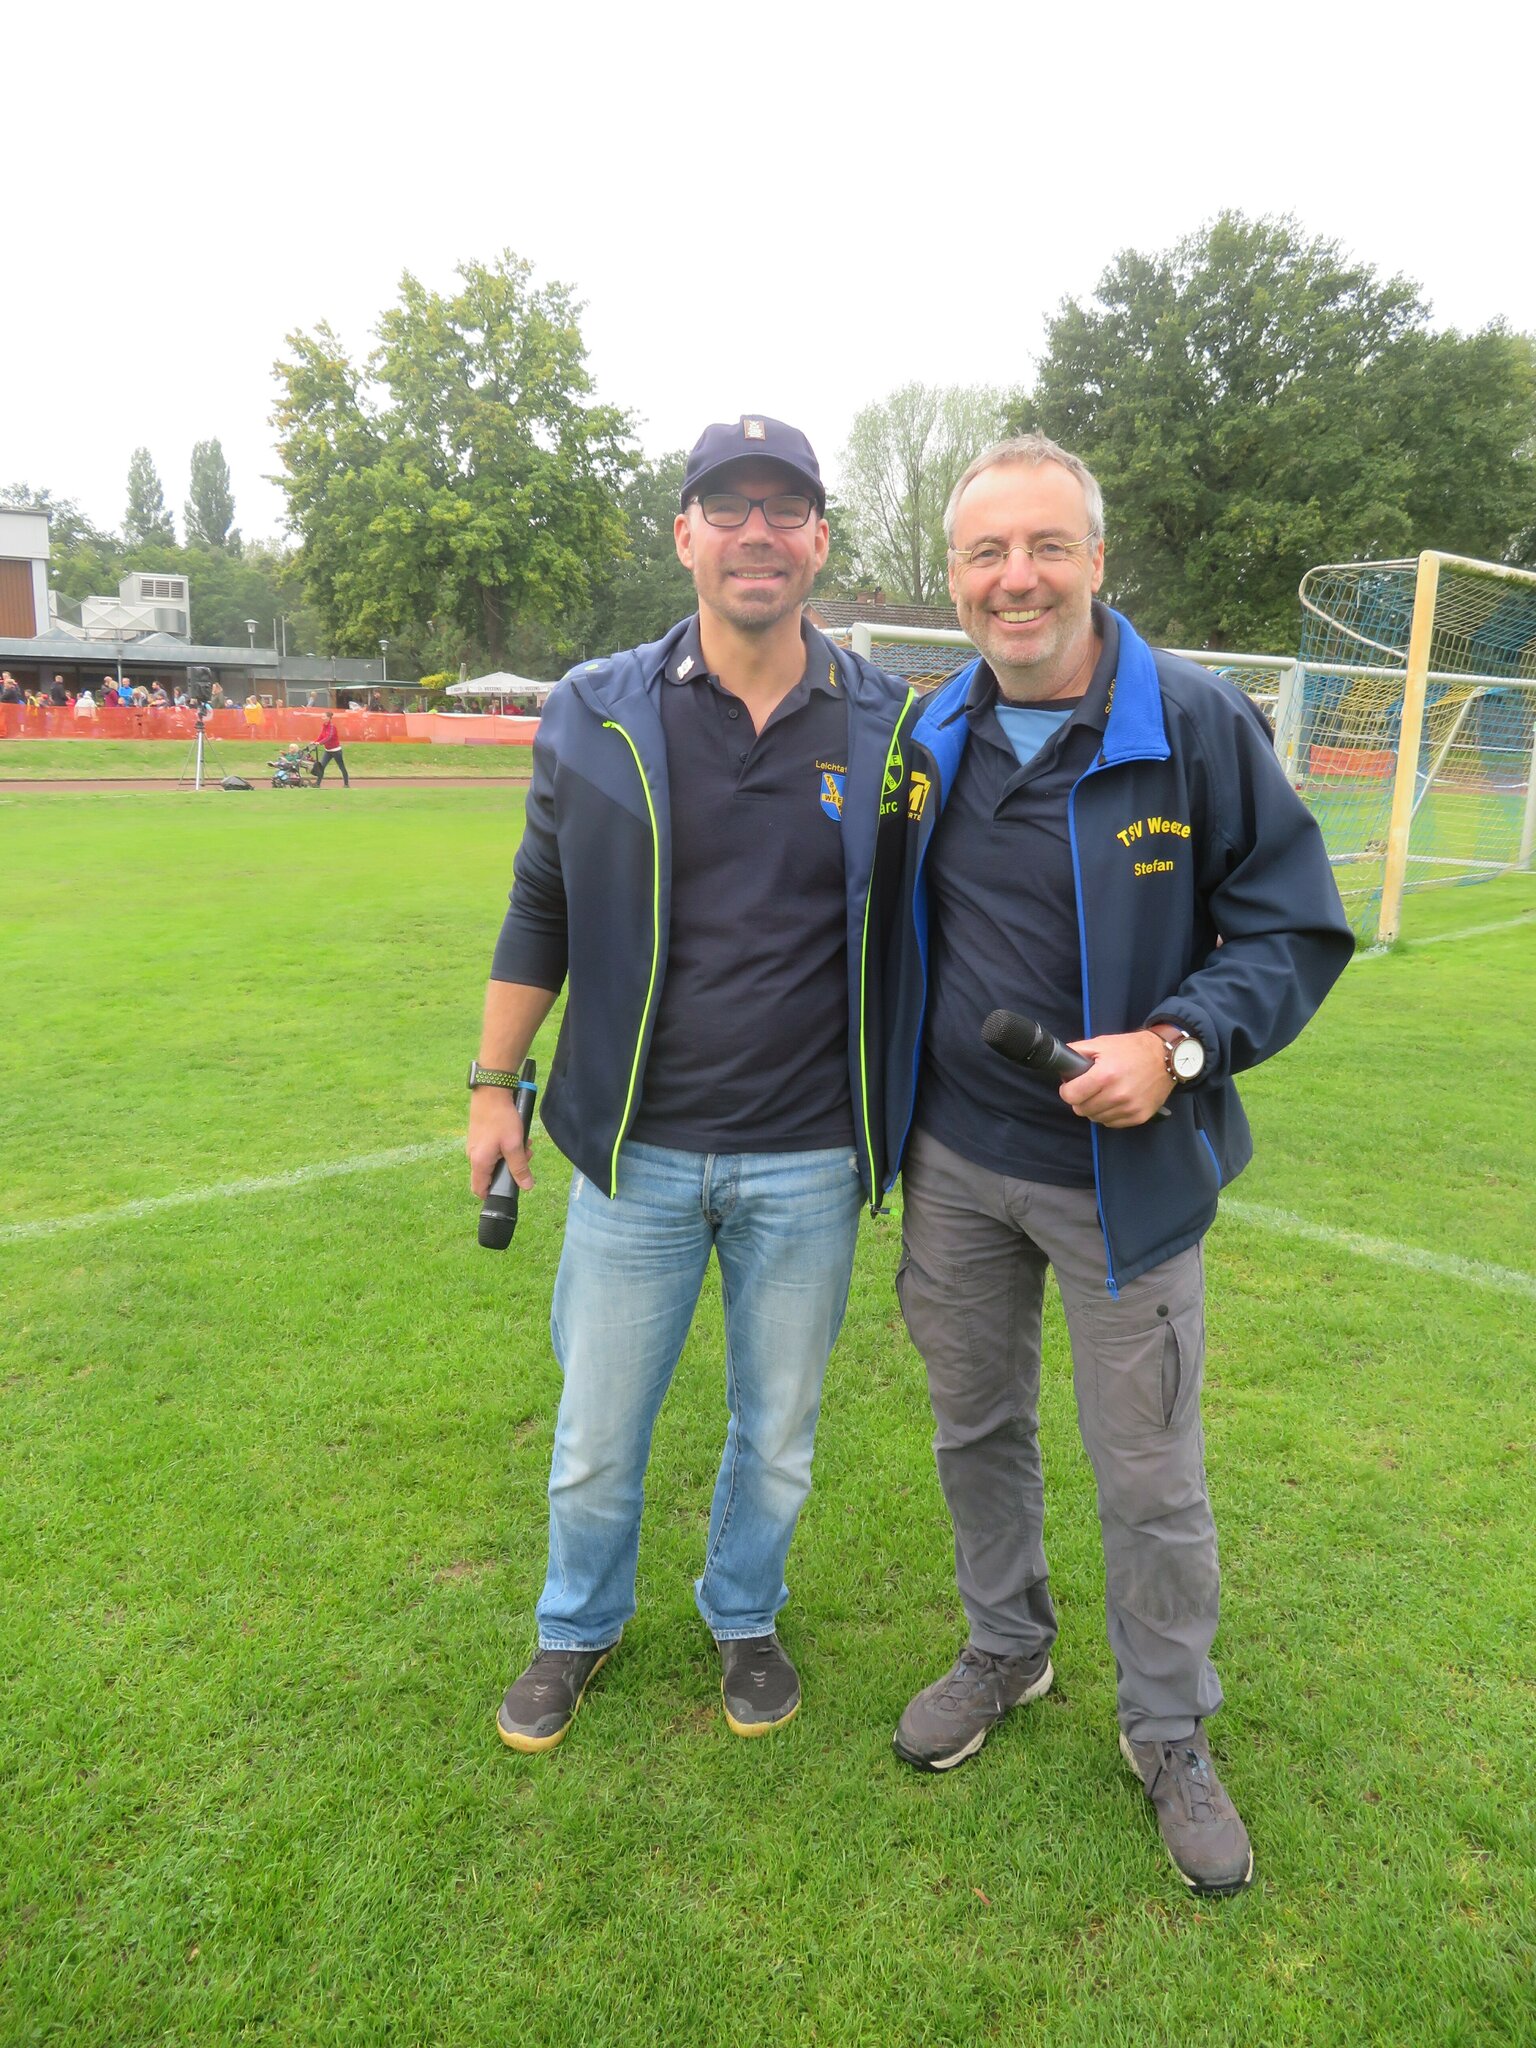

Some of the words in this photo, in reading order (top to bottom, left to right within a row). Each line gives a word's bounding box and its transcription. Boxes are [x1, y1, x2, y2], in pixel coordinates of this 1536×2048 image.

[815, 760, 848, 773] Leichtat
[825, 795, 843, 804] WEE
[880, 801, 898, 815] arc
[1116, 820, 1143, 848] TSV
[1147, 816, 1192, 839] Weeze
[1134, 859, 1174, 876] Stefan
